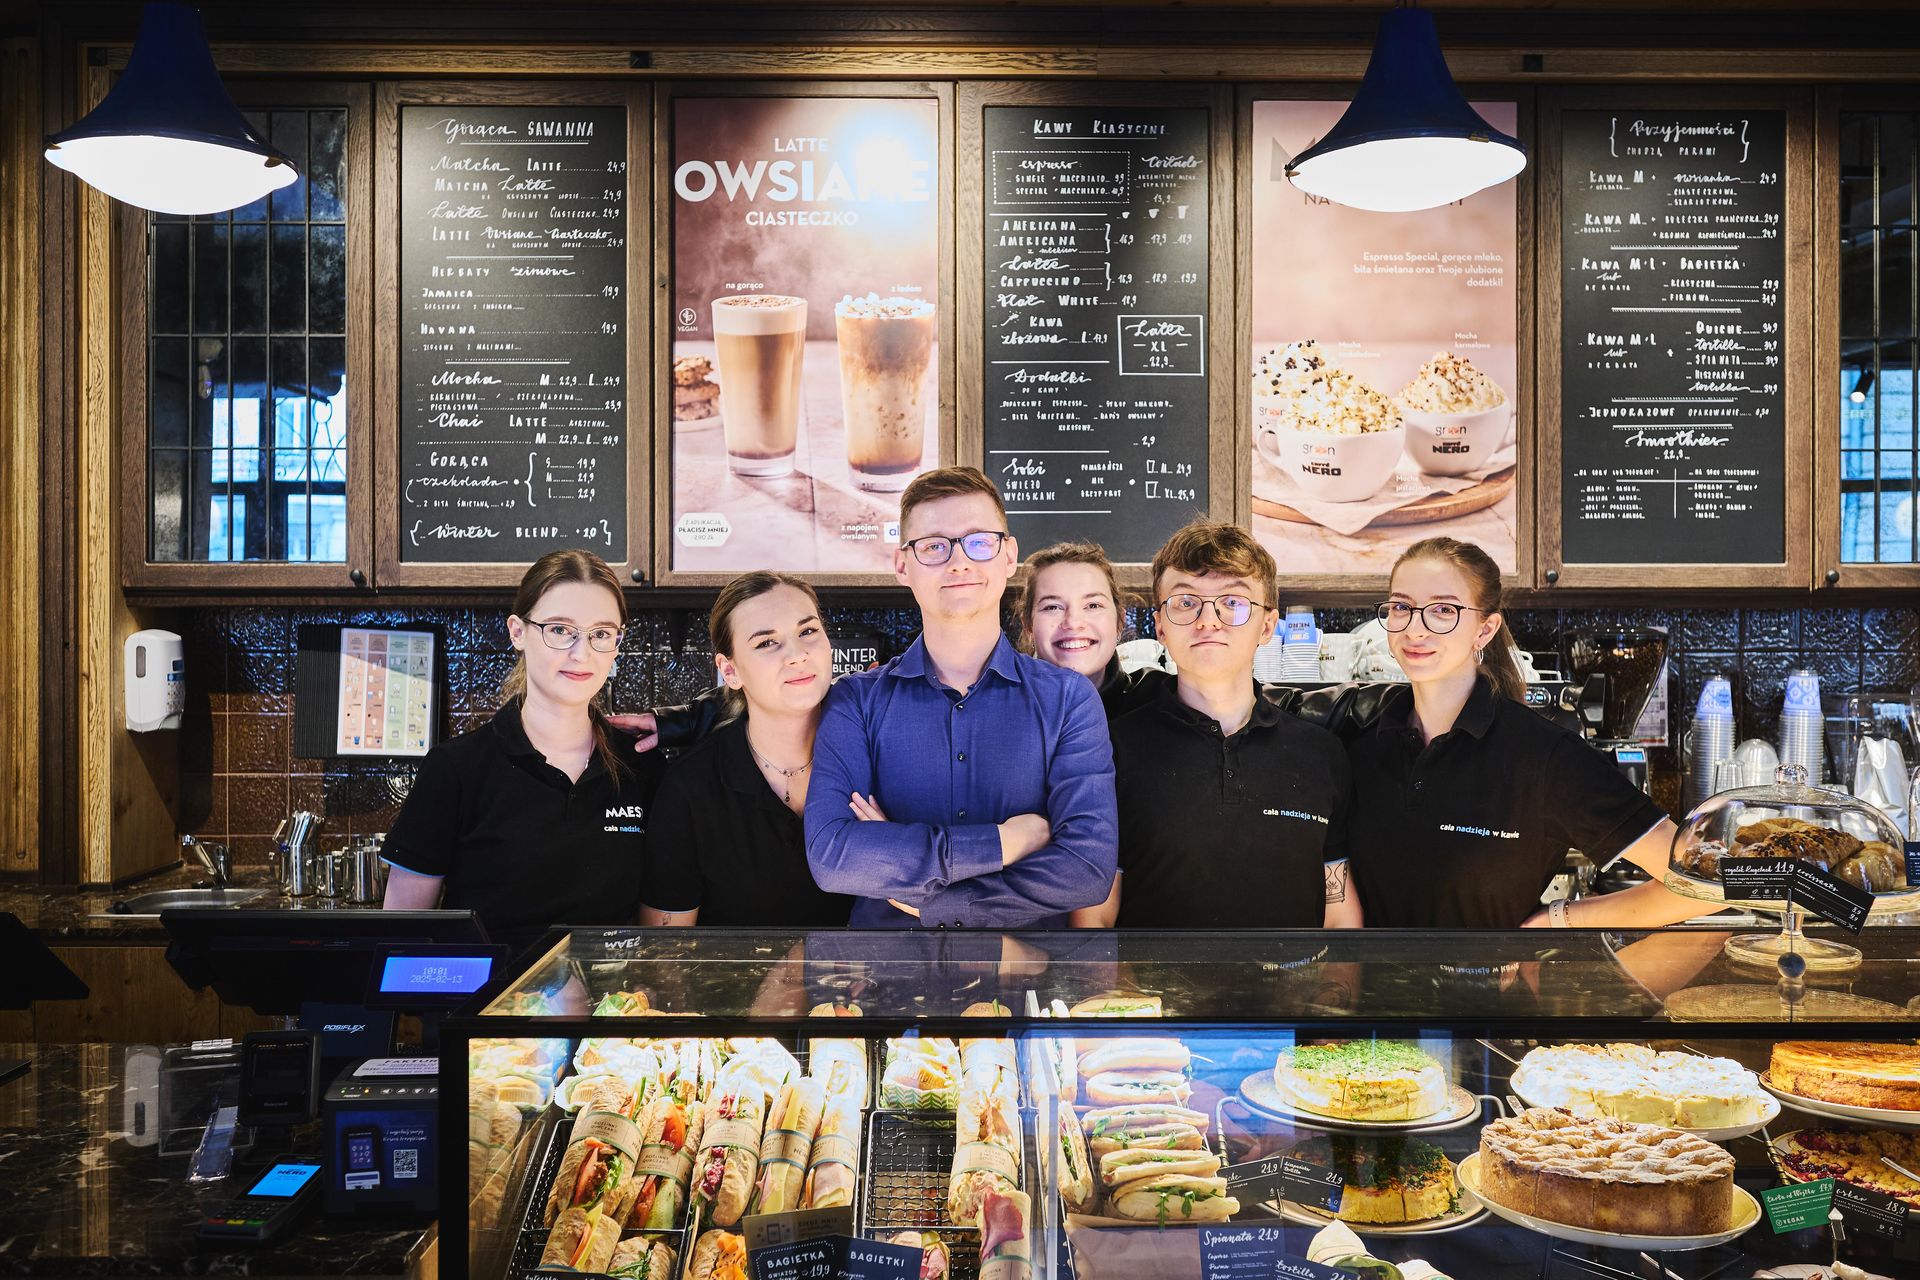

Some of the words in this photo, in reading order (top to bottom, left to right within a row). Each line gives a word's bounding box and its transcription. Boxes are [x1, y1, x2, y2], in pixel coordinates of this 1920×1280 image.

[427, 118, 517, 144] Gorąca
[527, 121, 595, 137] SAWANNA
[1033, 119, 1072, 134] KAWY
[1093, 120, 1166, 135] KLASYCZNE
[1629, 119, 1736, 143] Przyjemności
[774, 137, 829, 152] LATTE
[1679, 147, 1716, 156] PARAMI
[430, 155, 510, 172] Matcha
[527, 158, 562, 172] LATTE
[607, 161, 626, 174] 24,9
[434, 178, 489, 192] MATCHA
[497, 174, 556, 192] Latte
[674, 160, 930, 202] OWSIAE
[1015, 174, 1046, 183] SINGLE
[1589, 170, 1624, 184] KAWA
[1634, 170, 1644, 184] M
[1759, 172, 1778, 185] 24,9
[602, 189, 622, 204] 24,9
[1015, 187, 1048, 195] SPECIAL
[427, 200, 489, 219] Latte
[602, 208, 620, 220] 24,9
[745, 211, 859, 226] CIASTECZKO
[1584, 213, 1622, 225] KAWA
[1629, 212, 1641, 225] M
[1002, 220, 1076, 231] AMERICANA
[432, 226, 471, 241] LATTE
[606, 237, 624, 249] 24,9
[1000, 235, 1076, 247] AMERICANA
[1363, 252, 1404, 263] Espresso
[1405, 252, 1441, 263] Special,
[1441, 253, 1473, 264] gorące
[1474, 252, 1504, 262] mleko,
[1581, 257, 1620, 270] KAWA
[1629, 257, 1641, 270] M
[1680, 257, 1740, 270] BAGIETKA
[431, 266, 491, 278] HERBATY
[1353, 264, 1372, 274] bita
[1373, 264, 1414, 274] śmietana
[1415, 266, 1436, 274] oraz
[1437, 264, 1463, 276] Twoje
[1464, 264, 1504, 274] ulubione
[736, 283, 764, 291] gorąco
[1000, 275, 1082, 287] CAPPUCCINO
[1466, 277, 1504, 287] dodatki!
[422, 287, 474, 298] JAMAICA
[602, 285, 619, 300] 19,9
[1058, 295, 1100, 306] WHITE
[1029, 315, 1063, 327] KAWA
[420, 322, 476, 335] HAVANA
[601, 322, 617, 336] 19,9
[1587, 333, 1624, 346] KAWA
[1630, 333, 1641, 346] M
[1150, 341, 1167, 353] XL
[431, 371, 502, 386] Mocha
[540, 373, 550, 386] M
[559, 376, 577, 387] 22,9
[603, 376, 620, 388] 24,9
[540, 401, 548, 410] M
[1589, 407, 1676, 418] JEDNORAZOWE
[1688, 408, 1740, 417] OPAKOWANIE
[428, 412, 484, 428] Chai
[509, 415, 547, 428] LATTE
[535, 432, 547, 444] M
[559, 434, 578, 445] 22,9
[602, 434, 619, 446] 24,9
[1432, 445, 1470, 454] NERO
[430, 451, 489, 469] GORĄCA
[577, 457, 596, 471] 19,9
[1002, 458, 1046, 476] Soki
[1302, 464, 1342, 476] NERO
[577, 488, 596, 501] 22,9
[428, 523, 500, 539] Winter
[516, 527, 559, 538] BLEND
[847, 525, 879, 533] napojem
[840, 533, 878, 541] owsianym
[831, 648, 877, 663] INTER
[832, 663, 865, 673] BLEND
[1263, 808, 1279, 816] cała
[1280, 808, 1311, 820] nadzieja
[1456, 825, 1490, 837] nadzieja
[1774, 862, 1795, 873] 11,9
[323, 1024, 366, 1034] POSIFLEX
[1260, 1163, 1278, 1175] 21,9
[1325, 1171, 1343, 1185] 21,9
[1885, 1200, 1906, 1215] 18,9
[1782, 1216, 1805, 1225] VEGAN
[1203, 1230, 1256, 1247] Spianata
[1257, 1228, 1280, 1243] 21,9
[767, 1250, 825, 1269] BAGIETKA
[850, 1251, 906, 1267] BAGIETKI
[809, 1264, 831, 1278] 19,9
